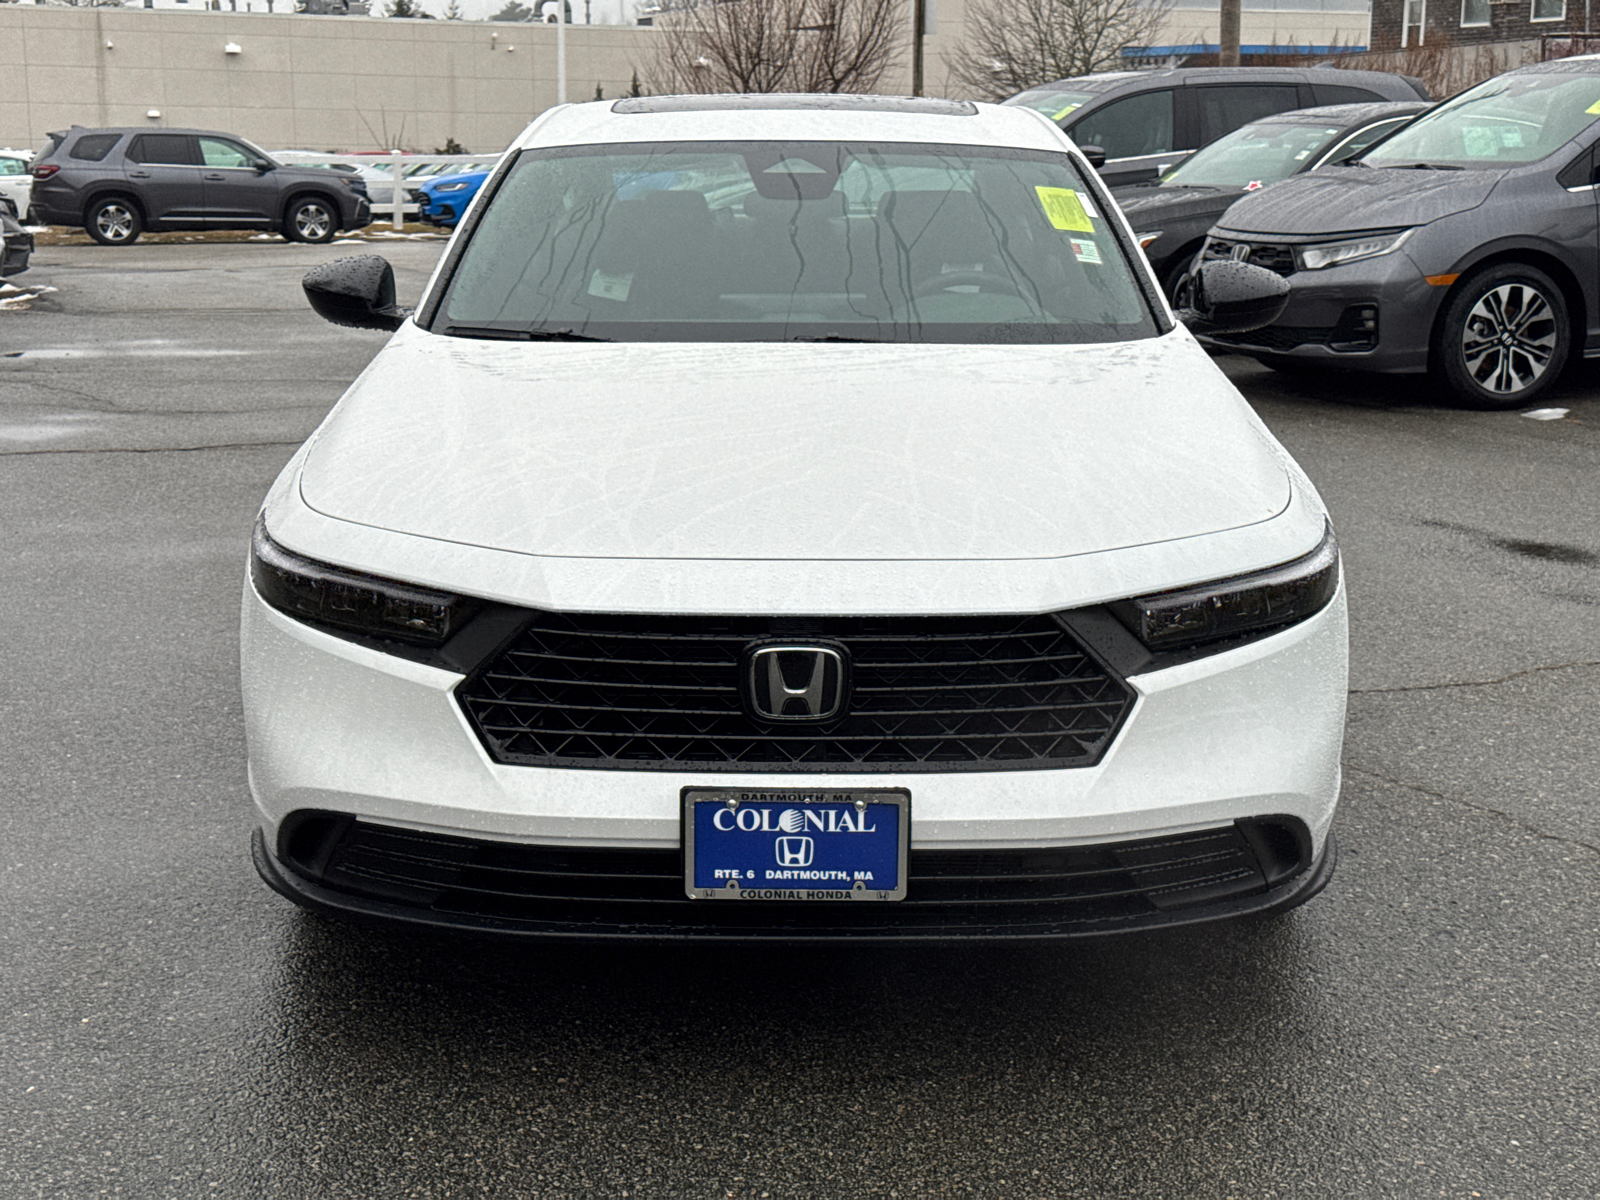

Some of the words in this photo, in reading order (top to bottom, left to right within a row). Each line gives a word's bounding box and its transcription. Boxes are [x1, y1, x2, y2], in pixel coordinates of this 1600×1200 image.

[833, 794, 852, 802] MA
[713, 808, 876, 833] COLONIAL
[714, 869, 743, 879] RTE.
[746, 870, 755, 879] 6
[765, 870, 850, 881] DARTMOUTH,
[853, 871, 874, 880] MA
[740, 889, 803, 899] COLONIAL
[806, 890, 852, 900] HONDA
